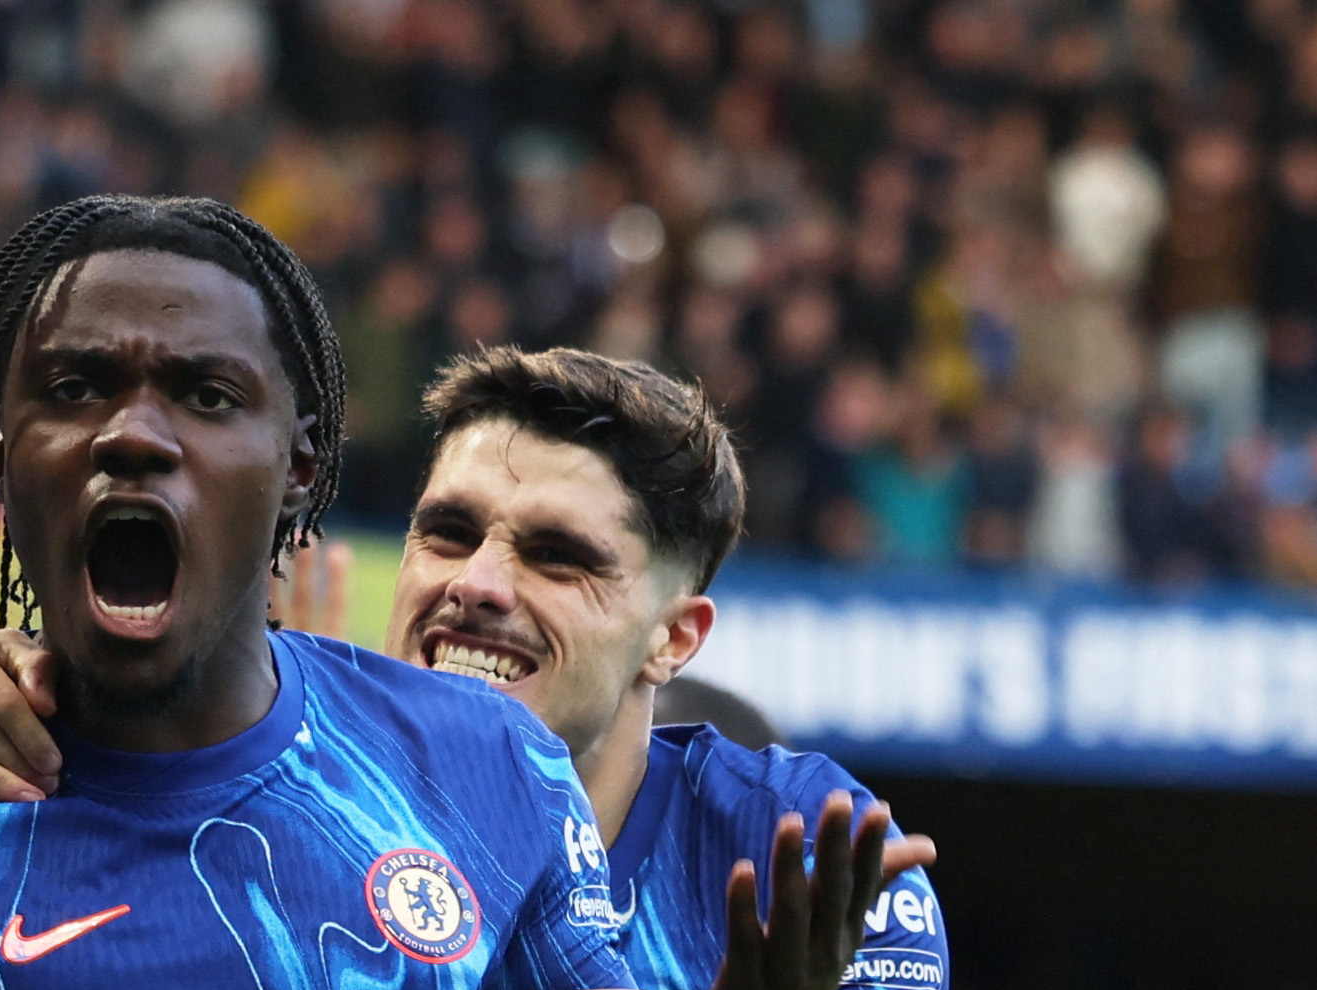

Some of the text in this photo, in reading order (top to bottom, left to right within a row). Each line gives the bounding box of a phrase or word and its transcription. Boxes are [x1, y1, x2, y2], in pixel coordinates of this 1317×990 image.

[380, 854, 449, 878] CHELSEA
[864, 889, 936, 936] ver
[841, 959, 941, 984] erup.com
